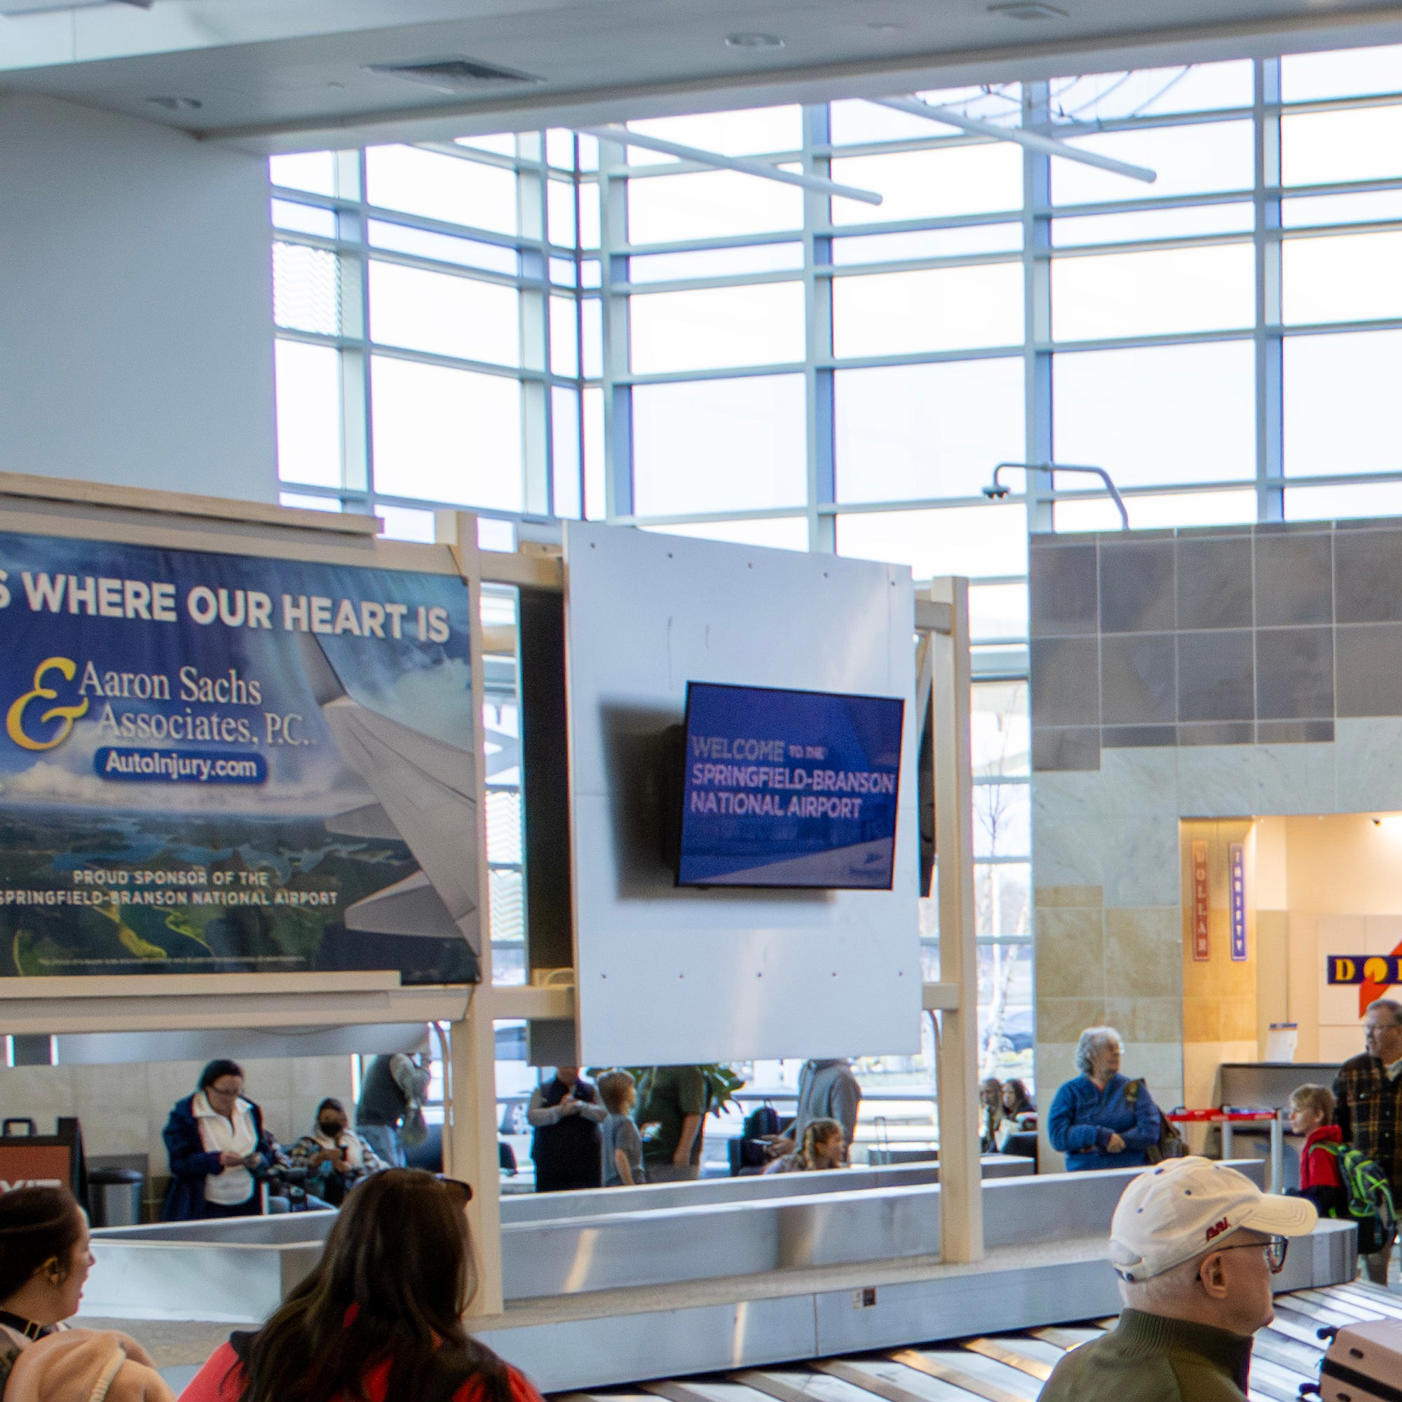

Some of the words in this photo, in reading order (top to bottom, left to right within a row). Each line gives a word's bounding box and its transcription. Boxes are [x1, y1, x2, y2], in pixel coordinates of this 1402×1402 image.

[21, 571, 178, 622] WHERE
[187, 587, 272, 630] OUR
[282, 595, 407, 638] HEART
[418, 605, 450, 644] IS
[79, 661, 171, 700] Aaron
[180, 666, 262, 705] Sachs
[6, 656, 88, 751] &
[101, 703, 260, 745] Associates,
[692, 736, 785, 762] WELCOME
[789, 745, 804, 760] TO
[106, 751, 257, 780] AutoInjury.com
[692, 764, 896, 794] SPRINGFIELD-BRANSON
[691, 792, 785, 817] NATIONAL
[787, 796, 863, 819] AIRPORT
[73, 870, 129, 886] PROUD
[134, 871, 206, 886] SPONSOR
[213, 871, 234, 886] OF
[238, 872, 268, 886] THE
[193, 890, 269, 906] NATIONAL
[274, 891, 337, 906] AIRPORT
